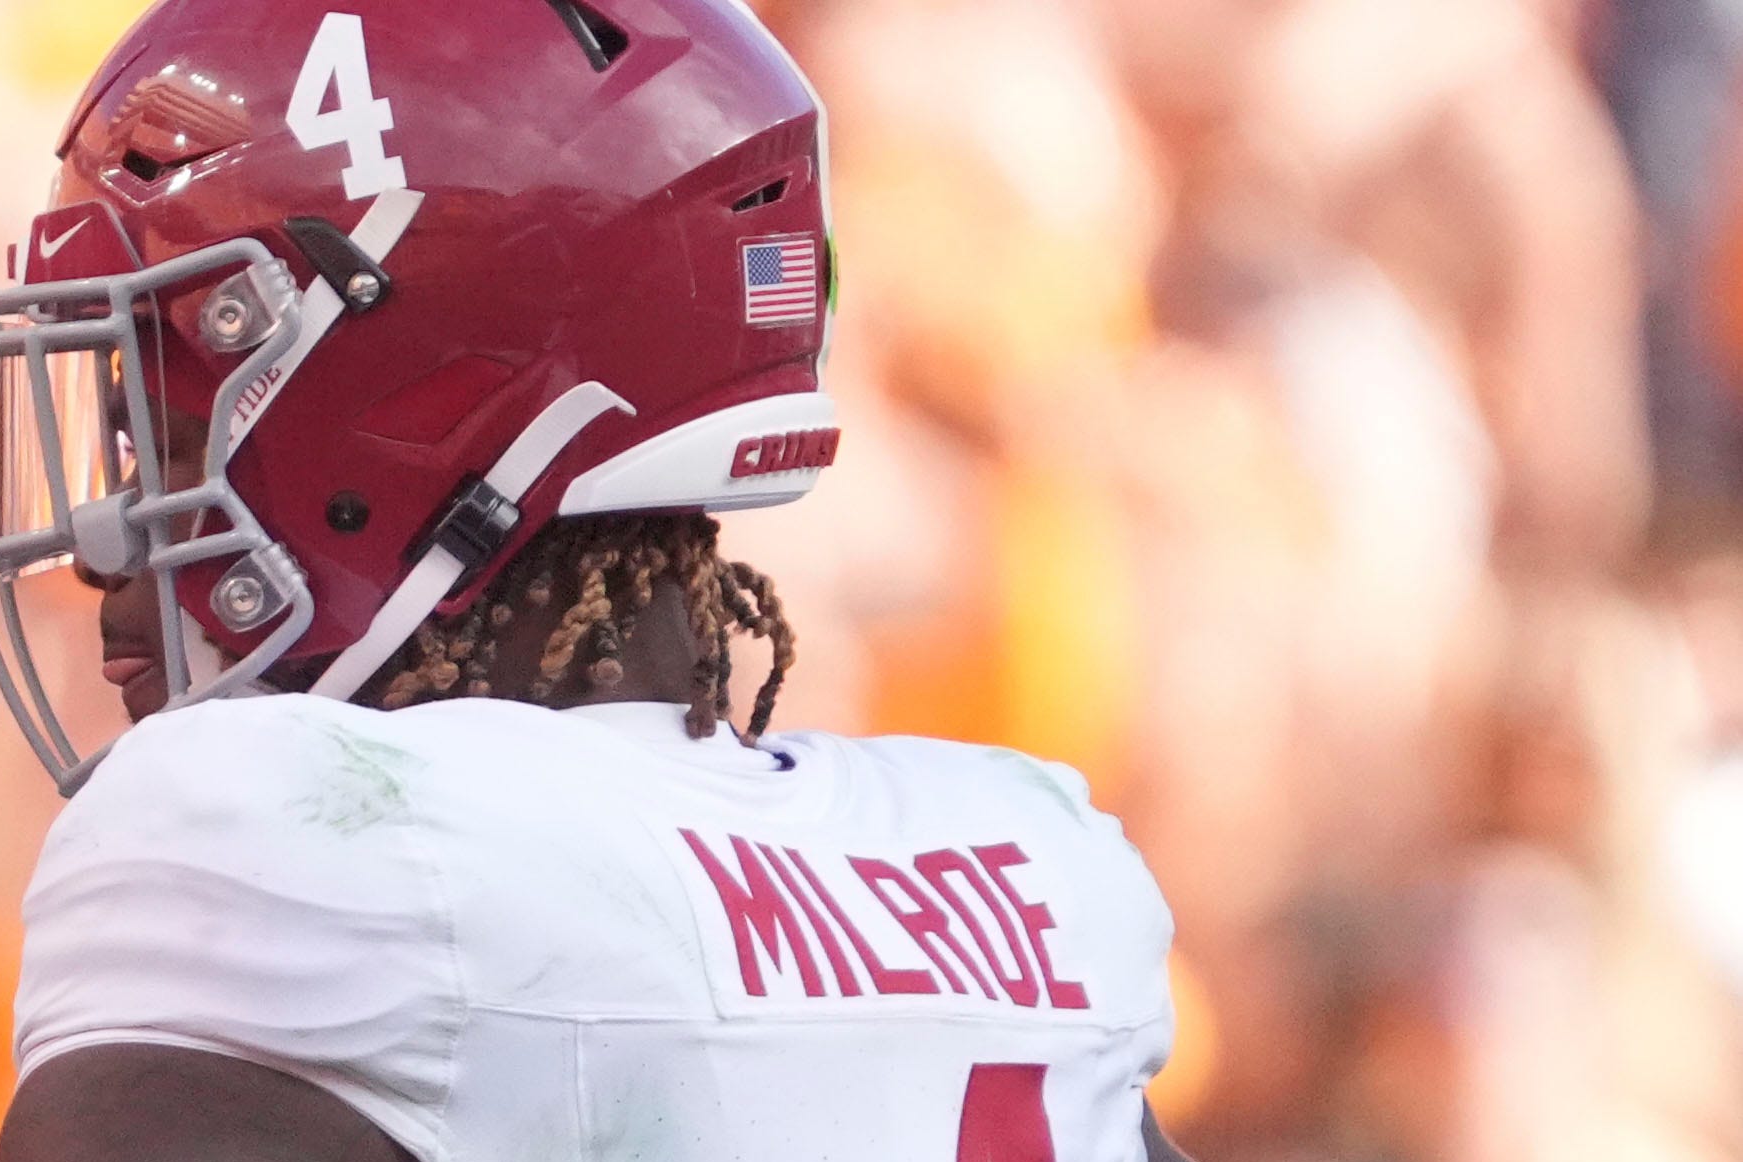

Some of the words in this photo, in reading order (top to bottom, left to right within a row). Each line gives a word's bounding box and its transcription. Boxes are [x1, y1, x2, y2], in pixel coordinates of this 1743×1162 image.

[285, 11, 407, 201] 4
[234, 367, 282, 422] TIDE
[676, 827, 1091, 1010] MILROE
